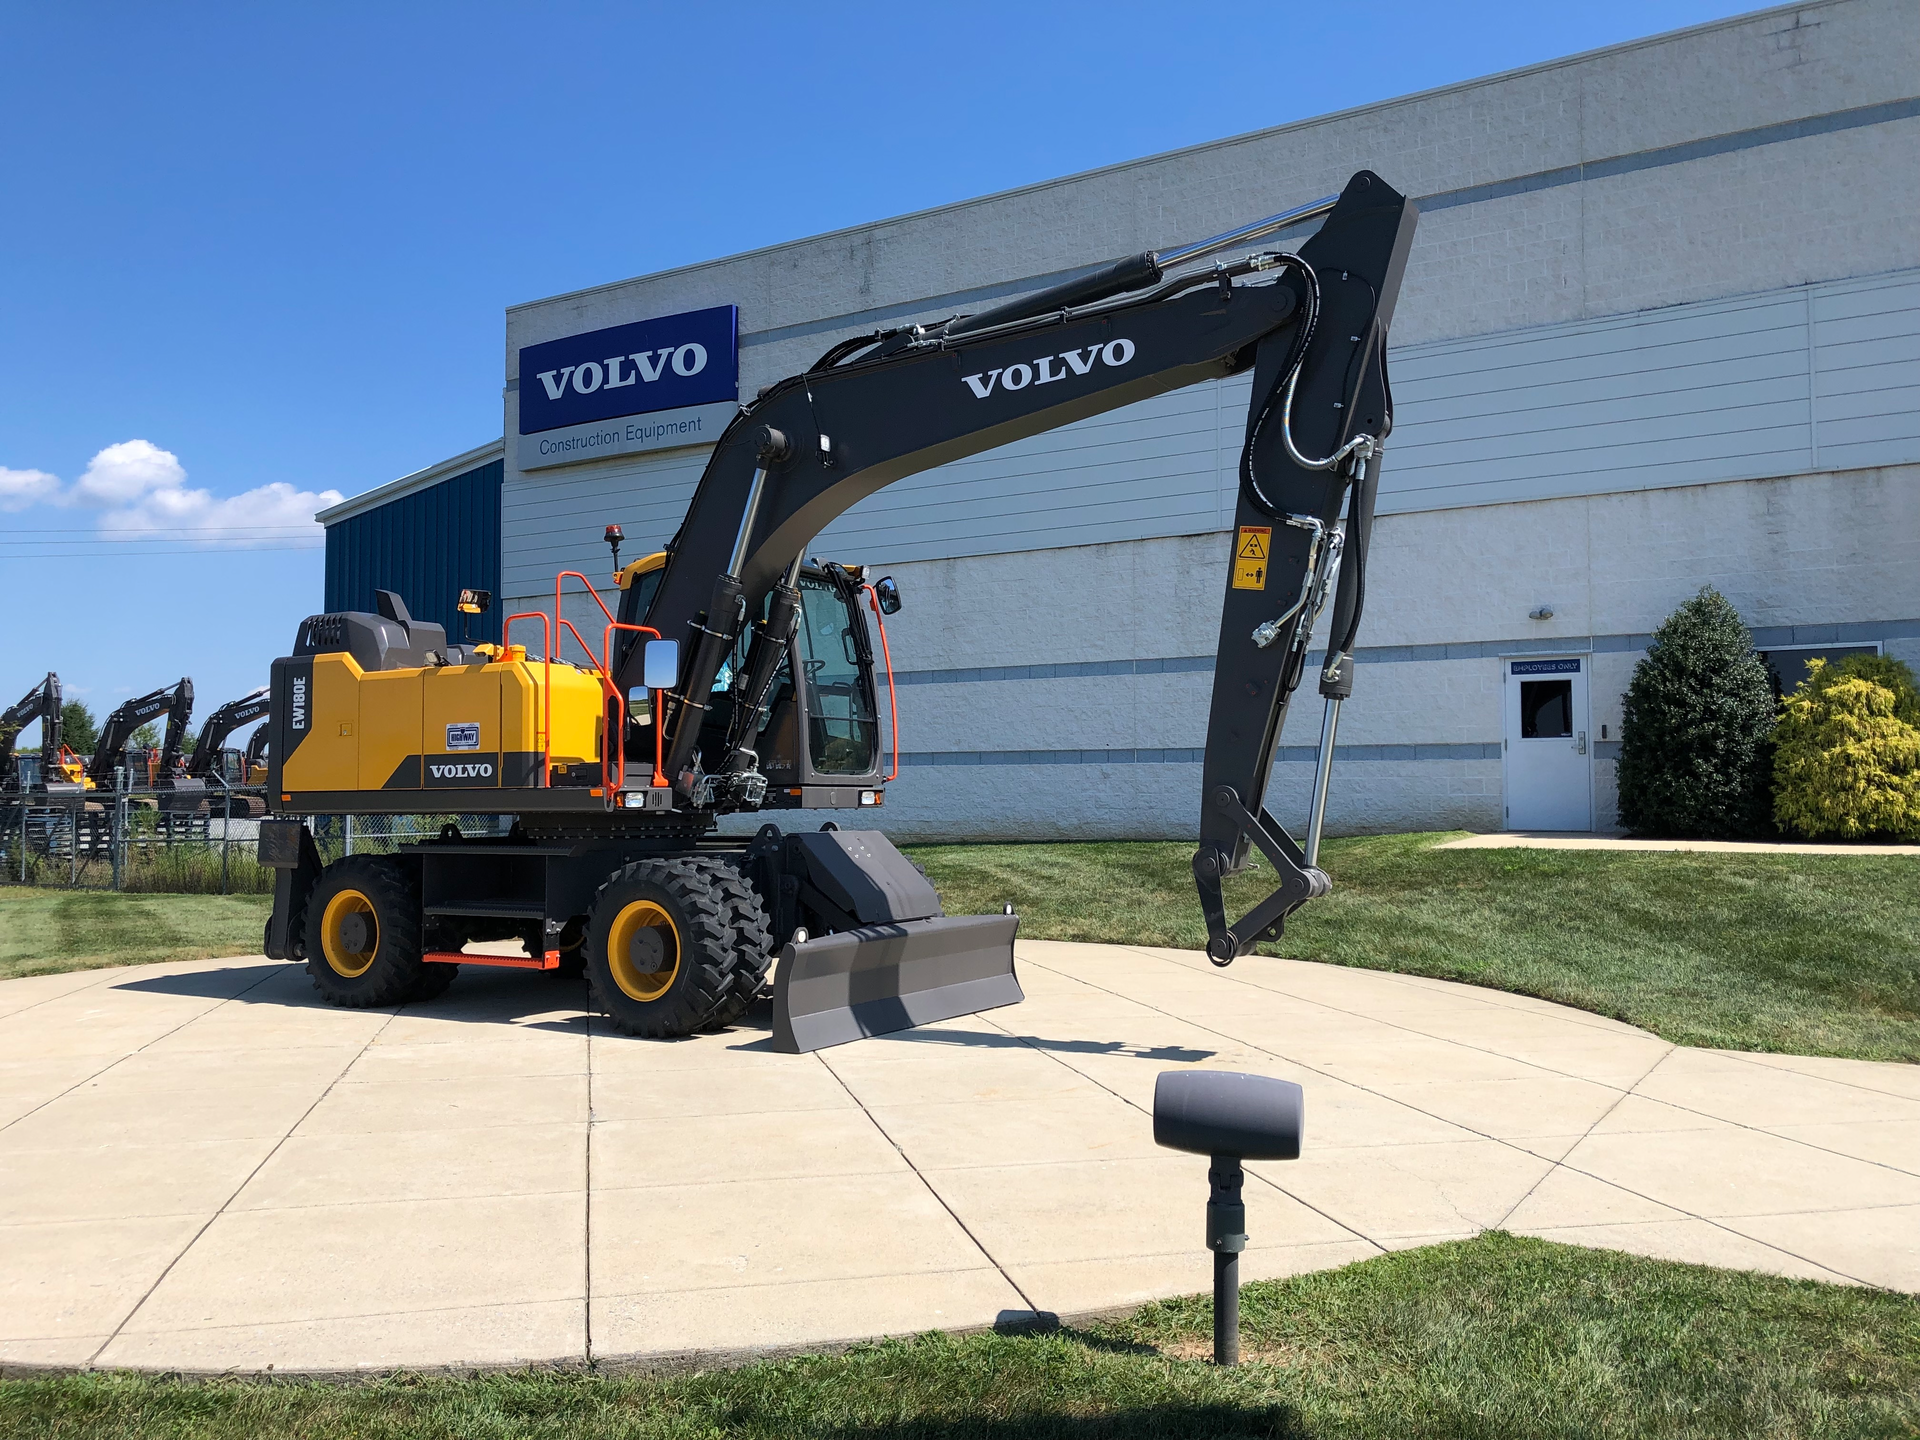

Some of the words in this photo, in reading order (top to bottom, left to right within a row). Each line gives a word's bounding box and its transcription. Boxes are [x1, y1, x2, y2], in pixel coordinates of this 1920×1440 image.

[536, 343, 708, 400] VOLVO
[961, 338, 1136, 399] VOLVO
[539, 430, 620, 455] Construction
[626, 417, 702, 443] Equipment
[1513, 664, 1556, 672] EMPLOYEES
[17, 703, 34, 717] VOLVO
[135, 702, 160, 716] VOLVO
[292, 676, 306, 730] EW180E
[234, 706, 260, 719] VOLVO
[430, 764, 492, 778] VOLVO
